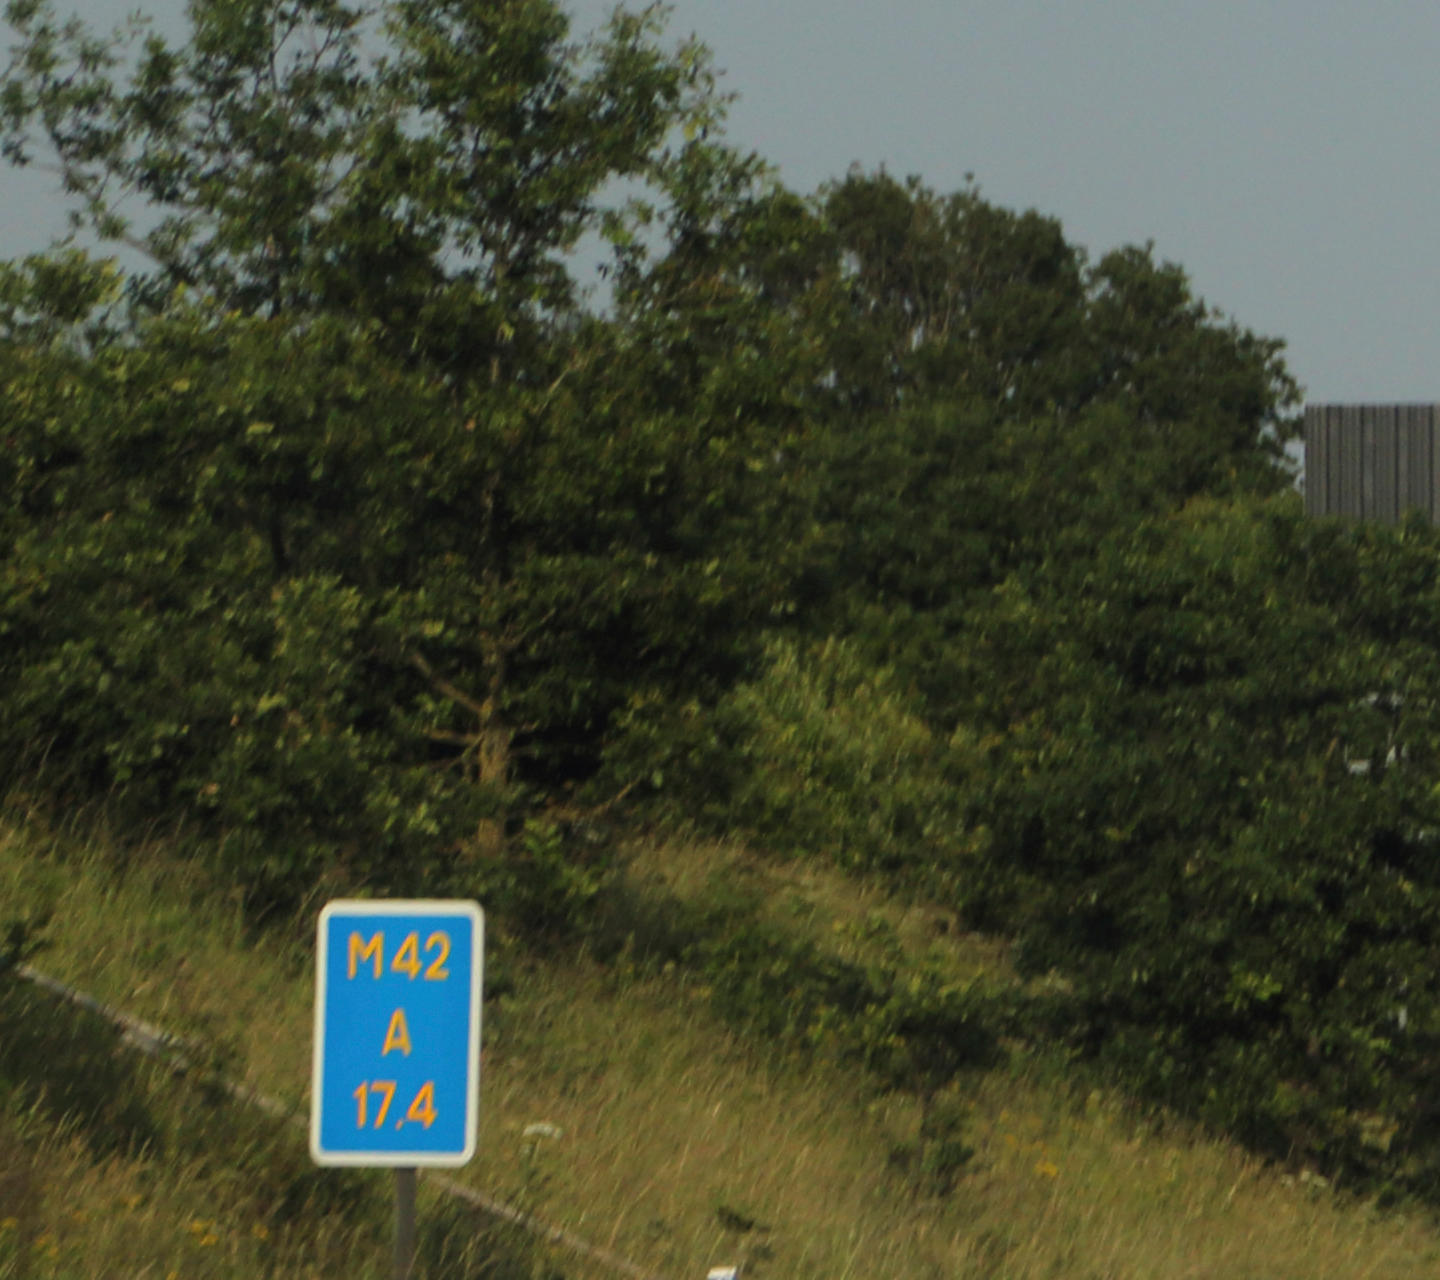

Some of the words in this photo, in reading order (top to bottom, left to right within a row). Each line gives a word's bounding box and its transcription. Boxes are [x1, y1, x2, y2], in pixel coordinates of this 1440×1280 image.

[346, 931, 452, 981] M42
[381, 1008, 412, 1057] A
[352, 1080, 438, 1130] 17.4
